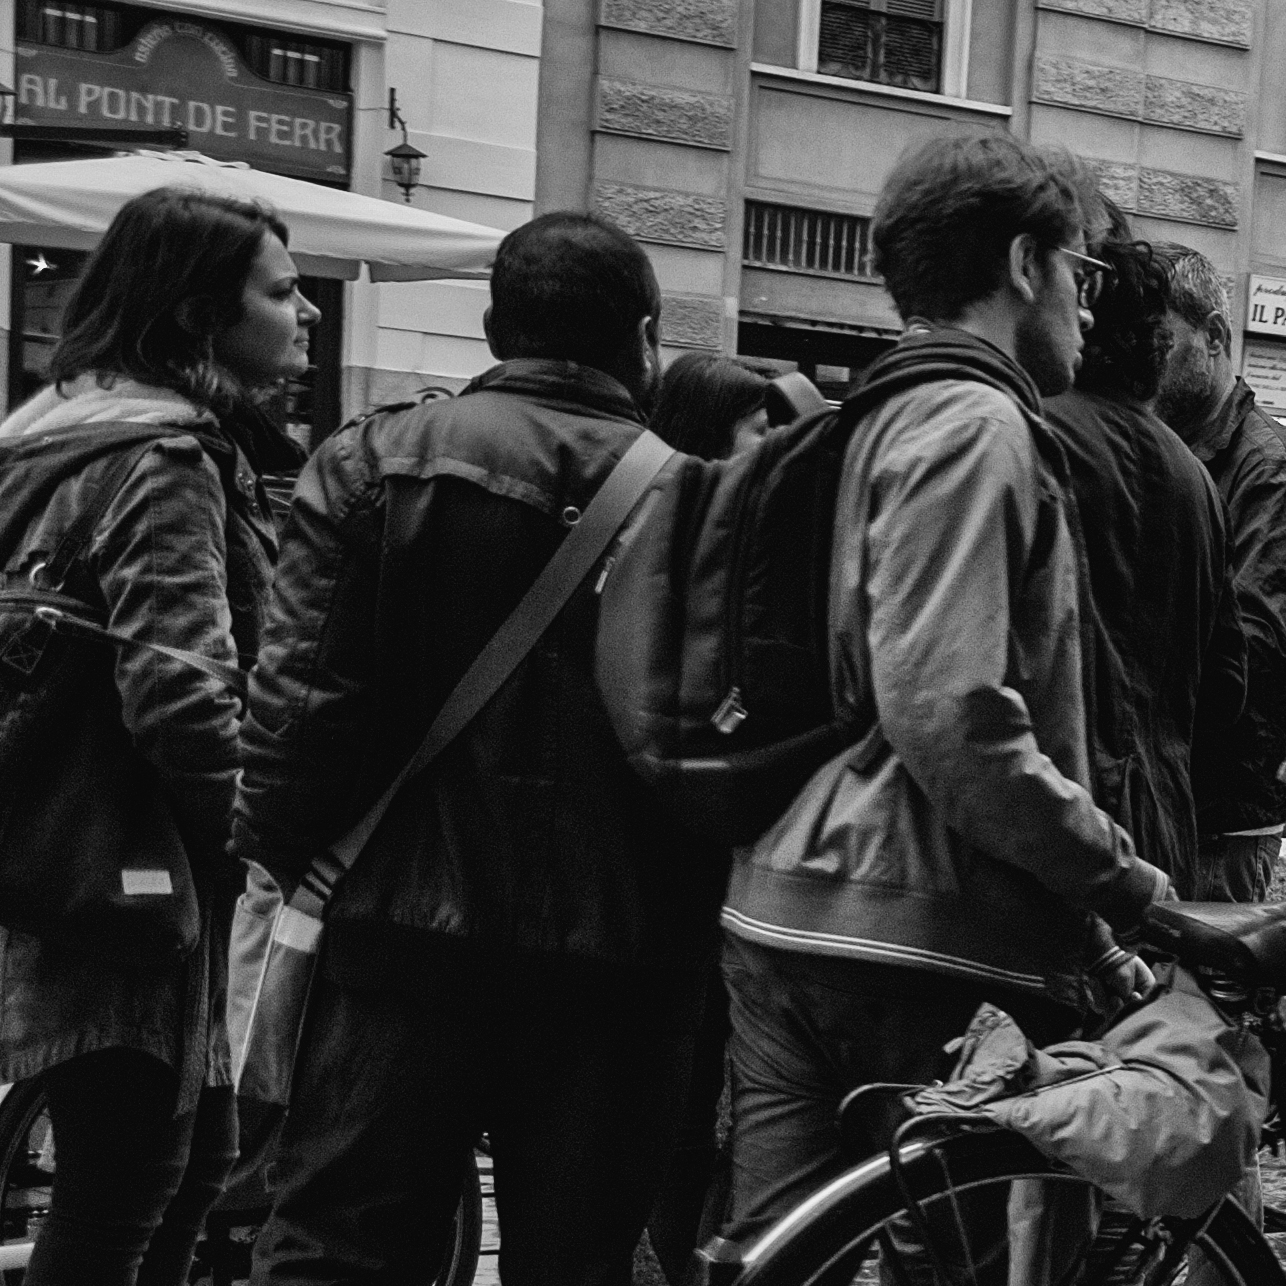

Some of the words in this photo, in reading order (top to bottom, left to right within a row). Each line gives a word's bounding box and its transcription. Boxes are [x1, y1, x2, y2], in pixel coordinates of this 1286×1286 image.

[19, 73, 68, 111] AL
[77, 82, 179, 128] PONT
[187, 100, 239, 138] DE
[248, 109, 345, 154] FERR
[1251, 304, 1269, 324] IL
